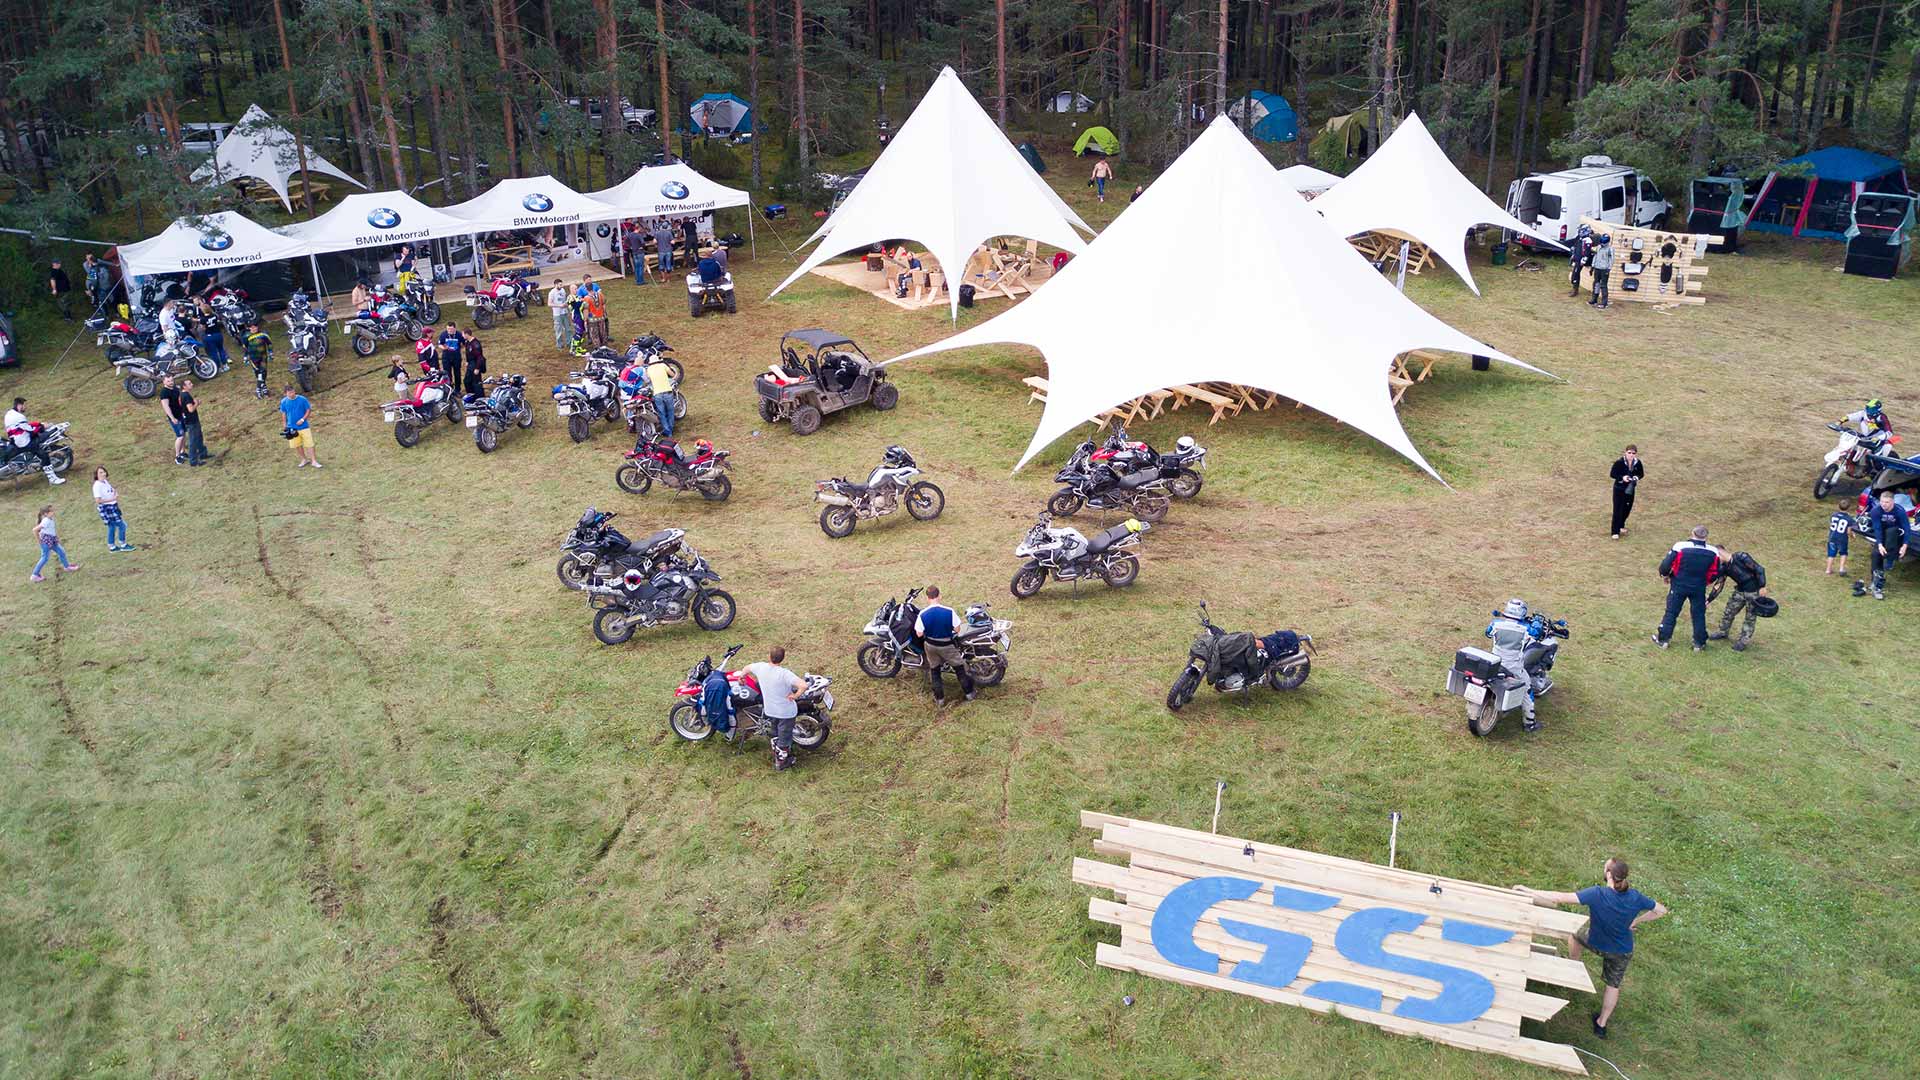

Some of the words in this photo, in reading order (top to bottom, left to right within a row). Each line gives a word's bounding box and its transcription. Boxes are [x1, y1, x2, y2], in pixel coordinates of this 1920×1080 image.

[654, 204, 677, 213] BMW
[678, 200, 715, 210] Motorrad
[513, 217, 538, 226] BMW
[539, 213, 580, 224] Motorrad
[355, 235, 383, 246] BMW
[384, 228, 430, 242] Motorrad
[181, 257, 211, 268] BMW
[213, 251, 262, 264] Motorrad
[1830, 516, 1848, 533] 58
[1151, 876, 1515, 1024] GS
